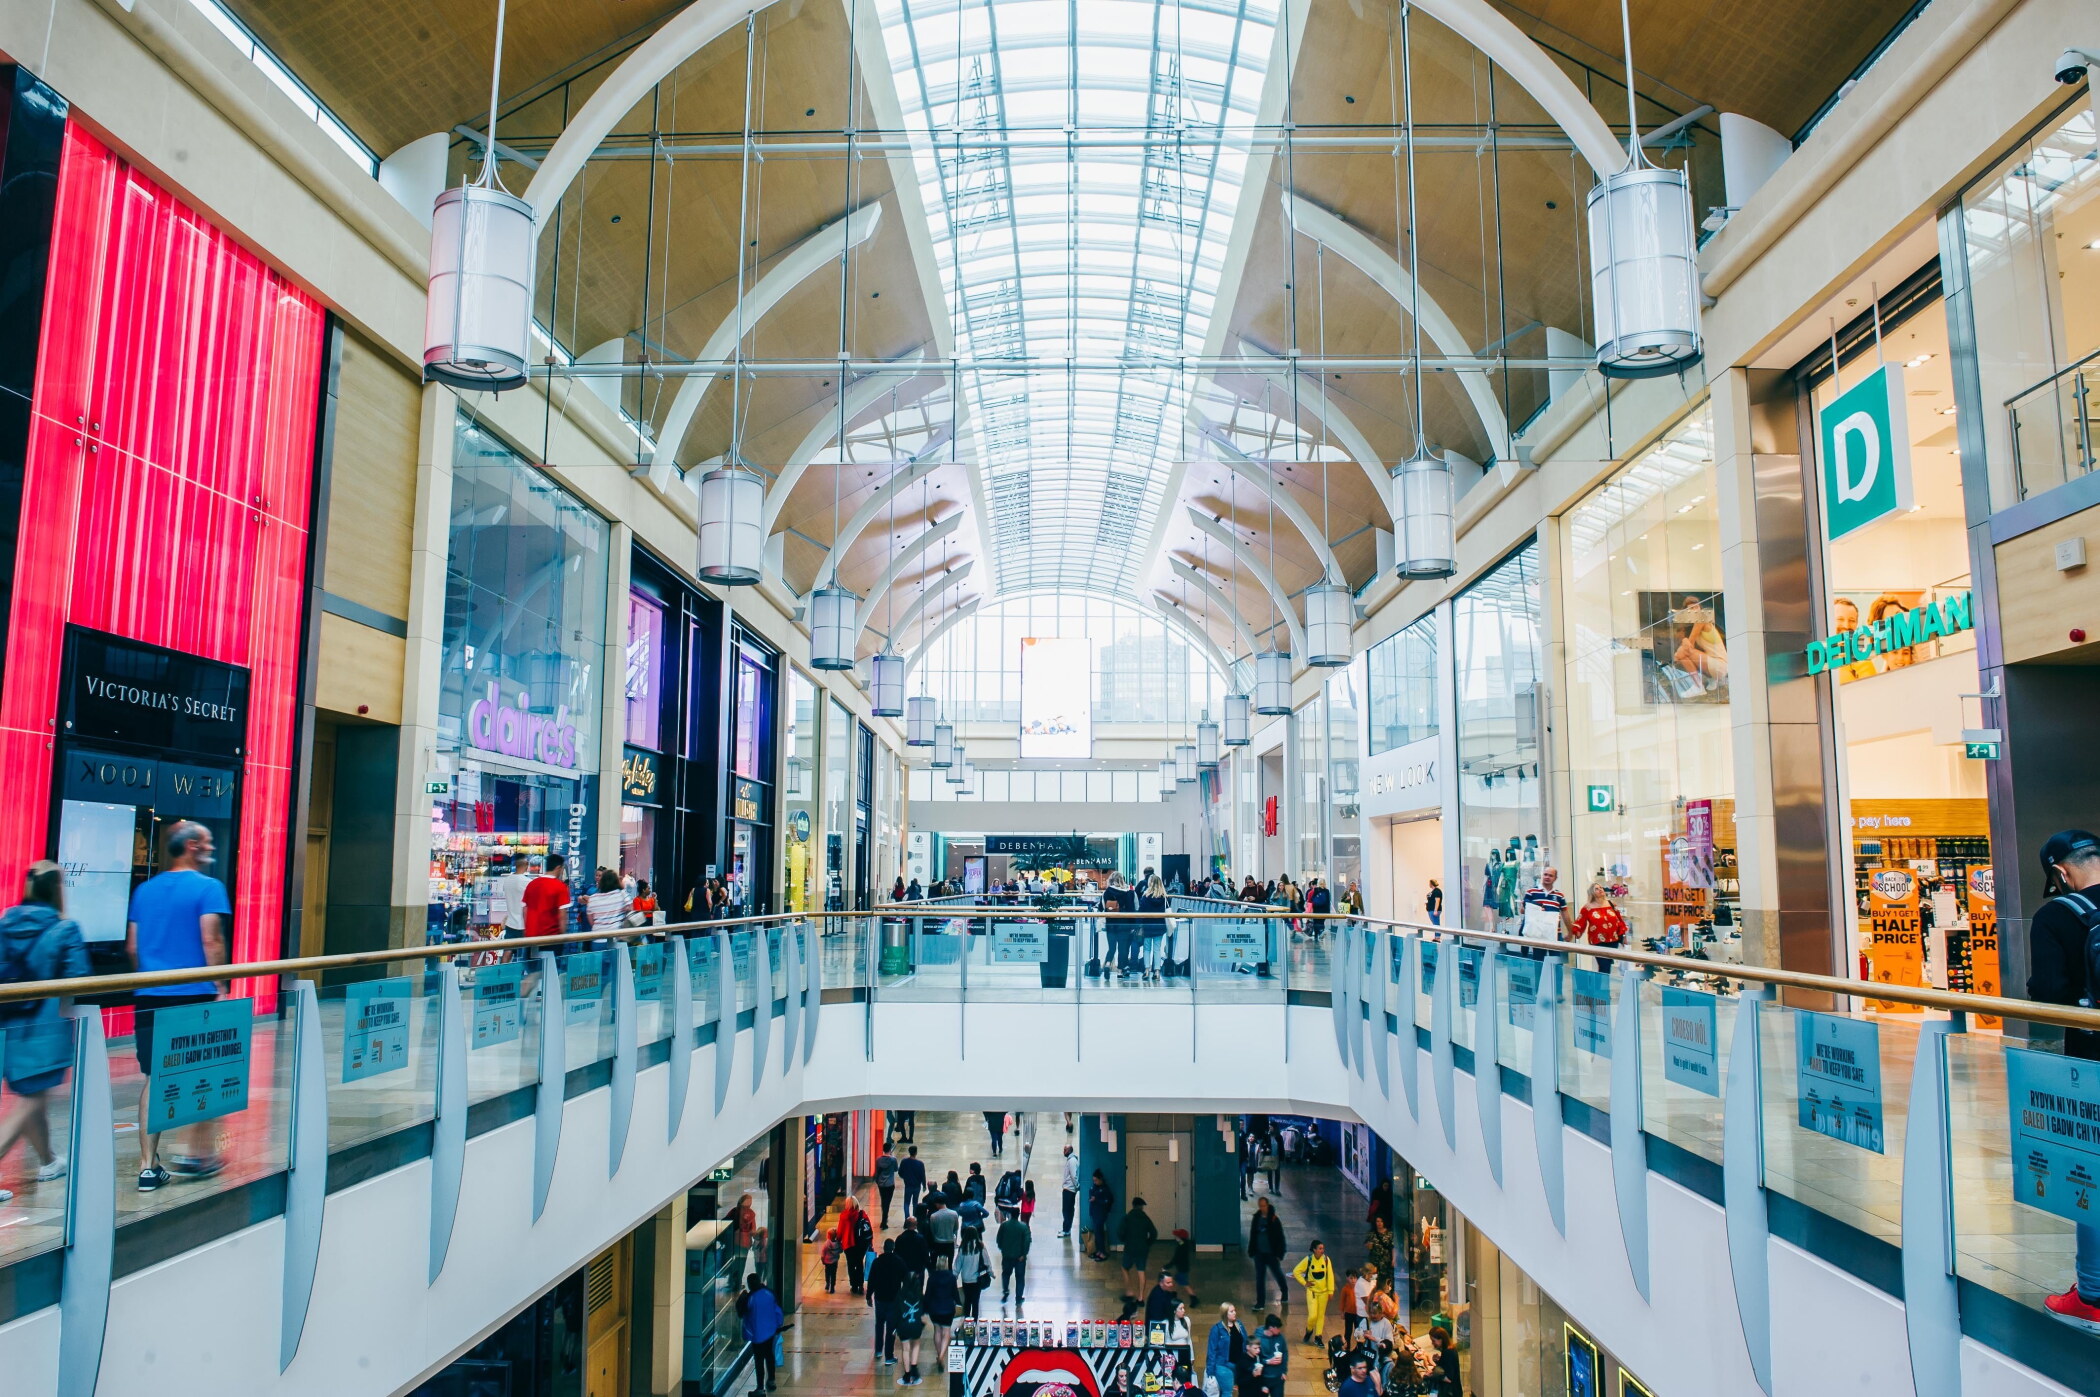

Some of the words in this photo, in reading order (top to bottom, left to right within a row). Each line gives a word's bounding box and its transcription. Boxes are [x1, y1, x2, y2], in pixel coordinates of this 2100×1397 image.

[1833, 411, 1880, 504] D
[1806, 590, 1975, 676] DEICHMAN
[86, 675, 179, 711] VICTORIA'S
[184, 696, 236, 722] SECRET
[468, 680, 577, 769] claire's
[1369, 774, 1394, 796] NEW
[1400, 761, 1435, 789] LOOK
[1592, 789, 1611, 807] D
[1859, 815, 1881, 828] pay
[1884, 814, 1911, 826] here
[568, 803, 587, 880] iercing
[1000, 841, 1066, 850] DEBENHA
[1068, 857, 1112, 866] BENHAMS
[1878, 883, 1910, 892] SCHOOL
[1977, 881, 1994, 892] SCH
[1664, 888, 1679, 901] BUY
[1685, 888, 1700, 901] GET
[1664, 905, 1682, 917] HALF
[1872, 910, 1891, 918] BUY
[1971, 912, 1992, 920] BUY
[479, 925, 502, 936] sae!
[1872, 919, 1919, 932] HALF
[1972, 922, 1998, 937] HA
[1815, 1043, 1831, 1059] WE'RE
[1831, 1047, 1855, 1065] WORKING
[1822, 1060, 1829, 1074] TO
[1829, 1061, 1841, 1077] KEEP
[1841, 1064, 1852, 1080] YOU
[1852, 1067, 1864, 1083] SAFE
[2030, 1090, 2055, 1112] RYDYN
[2056, 1096, 2066, 1115] NI
[2066, 1099, 2078, 1117] YN
[2022, 1110, 2045, 1130] GALED
[2046, 1116, 2050, 1132] I
[2051, 1117, 2075, 1138] GADW
[2076, 1123, 2091, 1142] CHI
